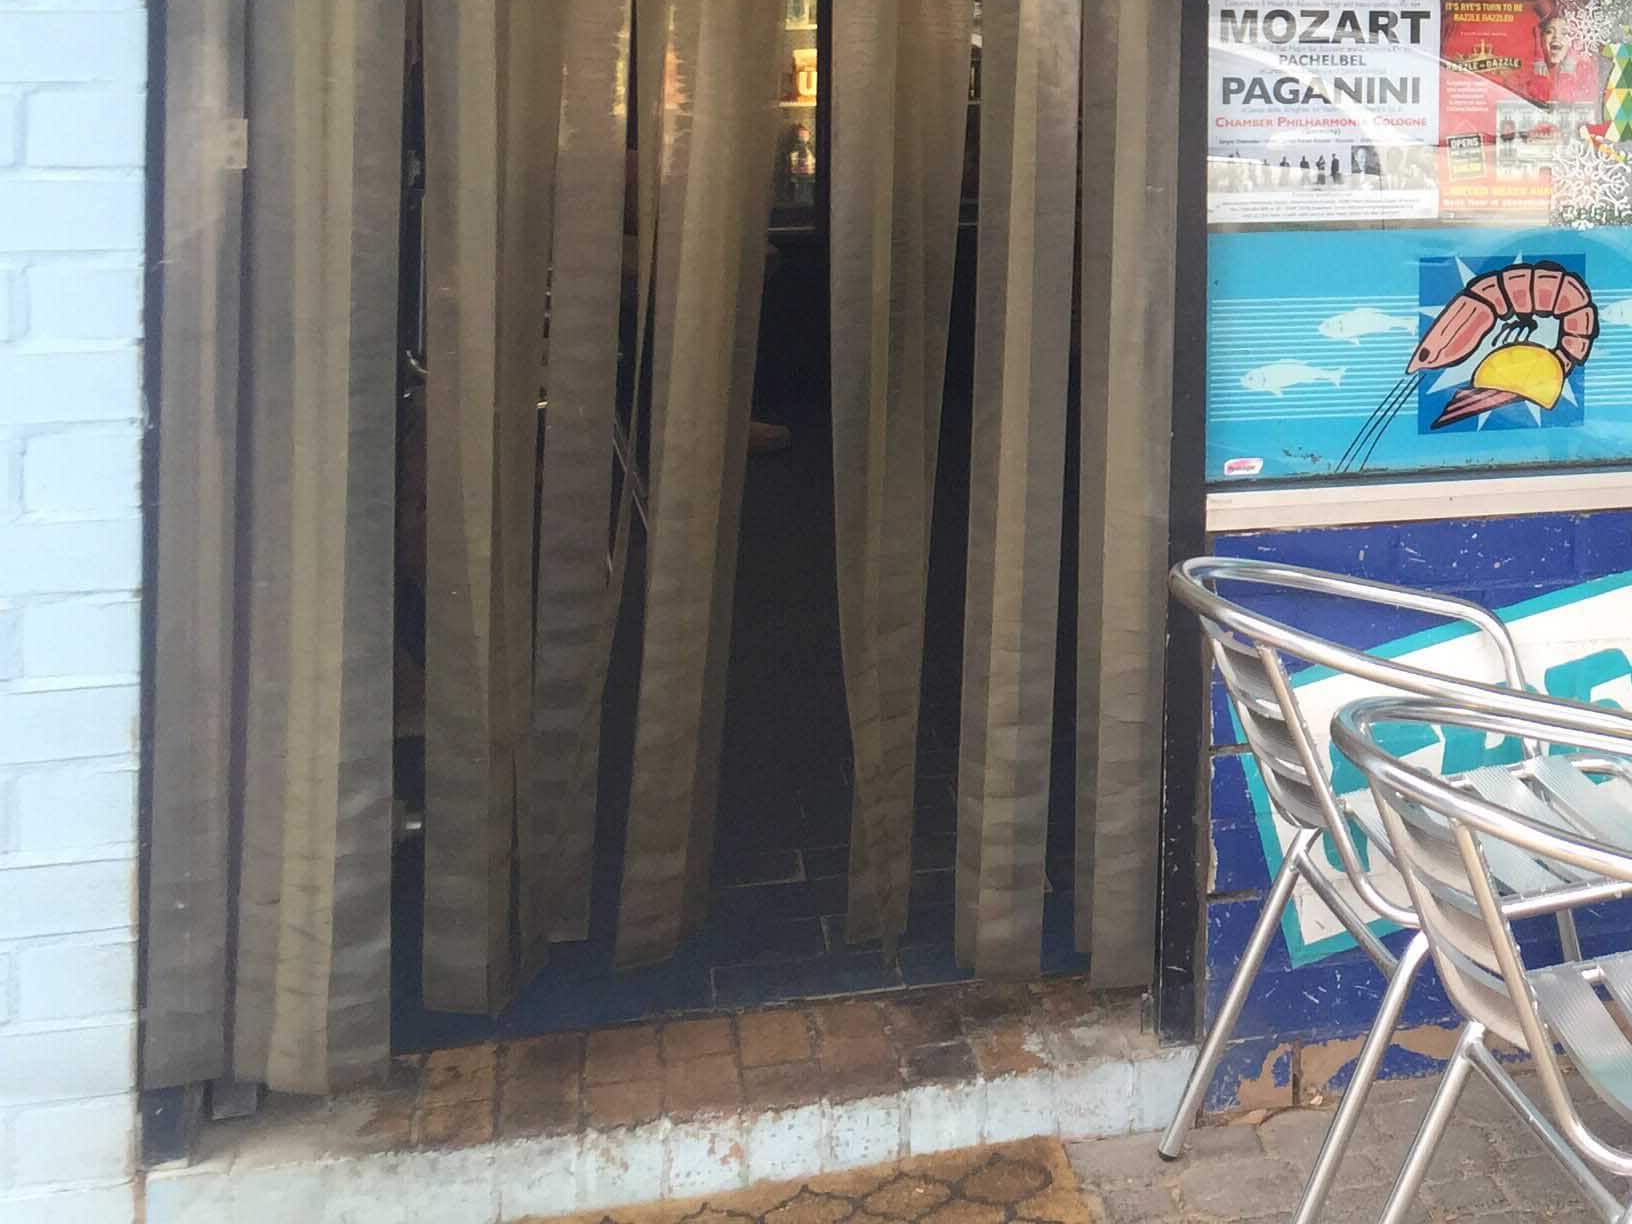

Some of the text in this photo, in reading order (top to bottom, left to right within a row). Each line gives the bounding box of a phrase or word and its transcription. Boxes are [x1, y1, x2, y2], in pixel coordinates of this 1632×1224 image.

[1220, 9, 1431, 45] MOZART
[1279, 54, 1367, 67] PACHELBEL
[1222, 76, 1421, 105] PAGANINI
[1216, 116, 1273, 128] CHAMBER
